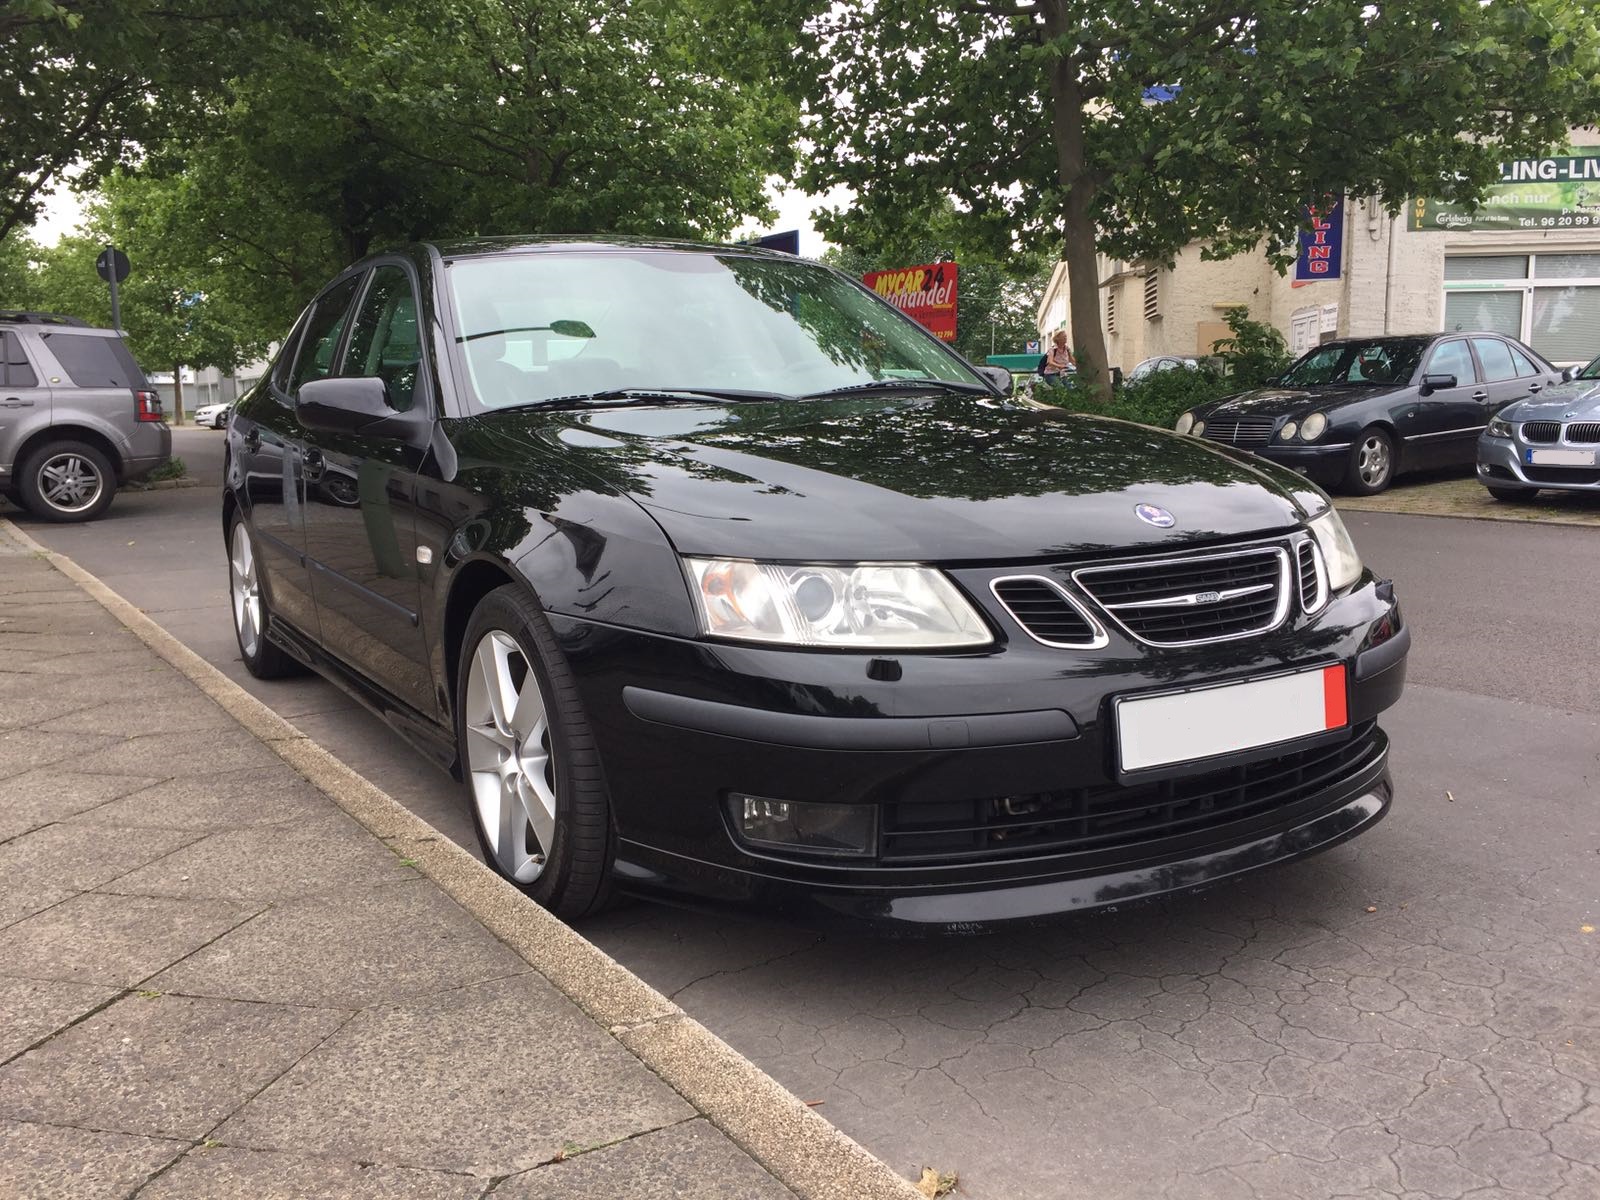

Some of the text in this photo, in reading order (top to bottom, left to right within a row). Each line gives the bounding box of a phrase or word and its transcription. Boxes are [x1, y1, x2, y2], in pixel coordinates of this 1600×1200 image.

[1435, 212, 1473, 228] Carlsberg
[1519, 217, 1538, 227] Tel.
[1541, 217, 1555, 226] 96
[1558, 217, 1572, 226] 20
[1575, 216, 1589, 225] 99
